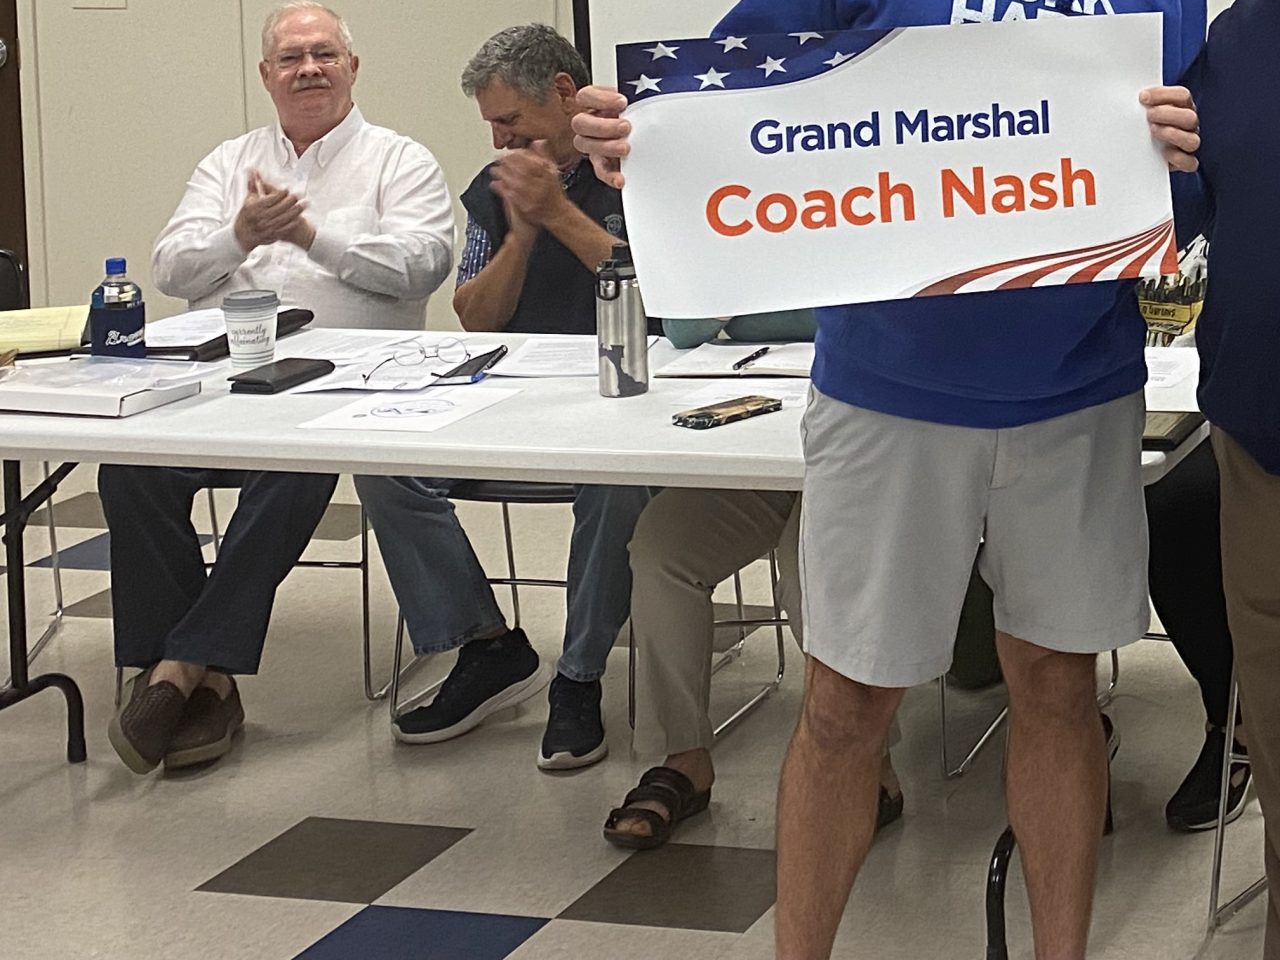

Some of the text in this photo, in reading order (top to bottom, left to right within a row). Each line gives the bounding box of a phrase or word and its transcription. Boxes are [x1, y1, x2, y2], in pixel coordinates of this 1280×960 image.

[750, 100, 1050, 155] Grand Marshal
[705, 157, 1096, 237] Coach Nash
